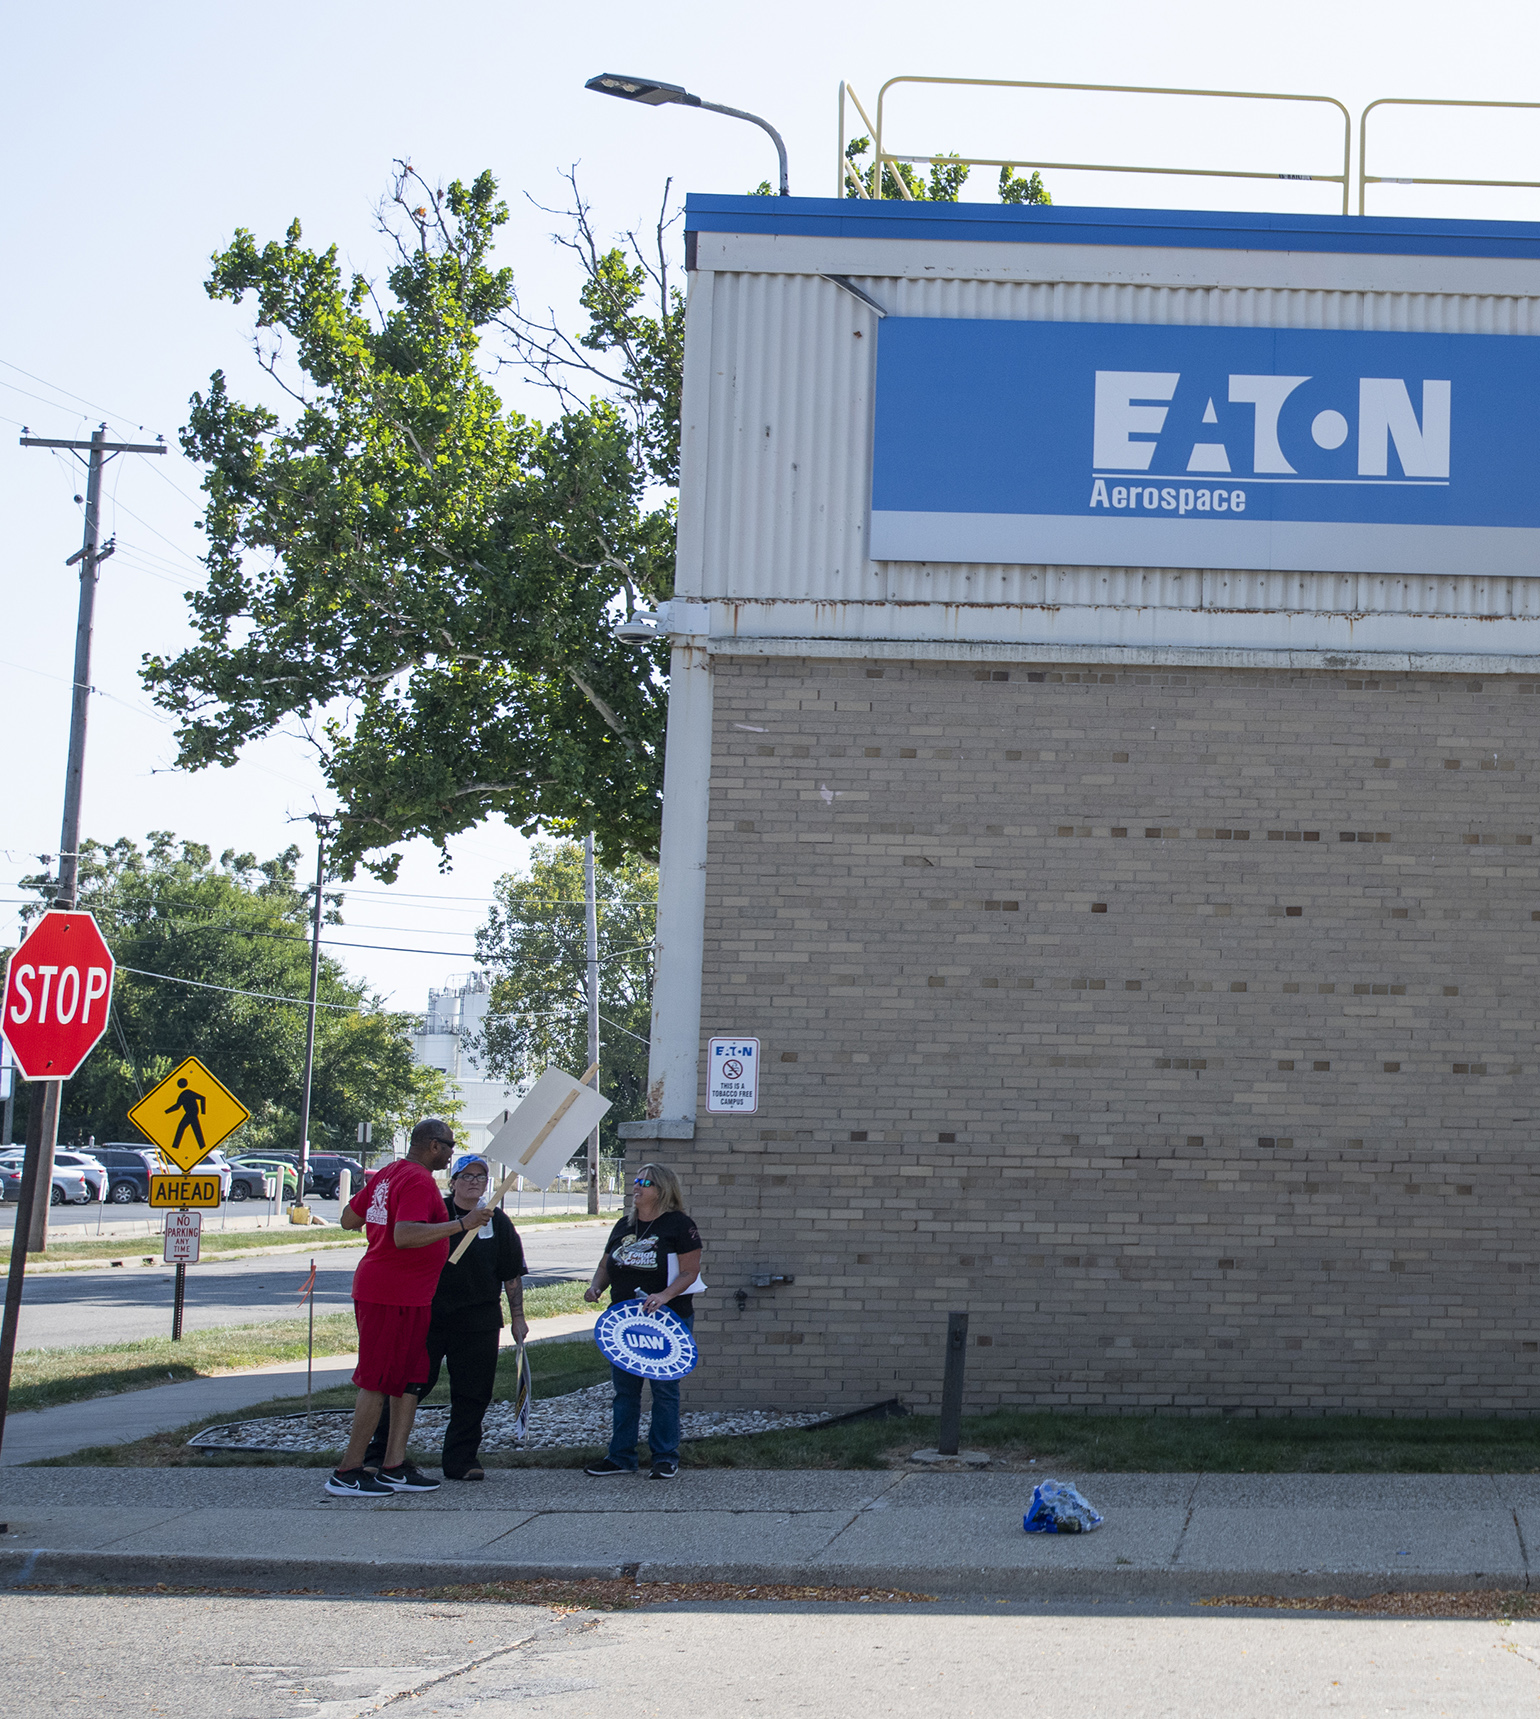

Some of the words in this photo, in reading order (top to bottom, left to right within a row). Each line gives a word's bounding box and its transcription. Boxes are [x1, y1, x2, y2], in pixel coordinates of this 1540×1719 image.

[1092, 370, 1451, 478] EATON
[1090, 478, 1246, 515] Aerospace
[10, 964, 108, 1025] STOP
[716, 1046, 752, 1056] EATON
[156, 1183, 214, 1200] AHEAD
[177, 1216, 190, 1226] NO
[168, 1228, 198, 1238] PARKING
[624, 1257, 656, 1265] Cookie
[625, 1333, 665, 1351] UAW
